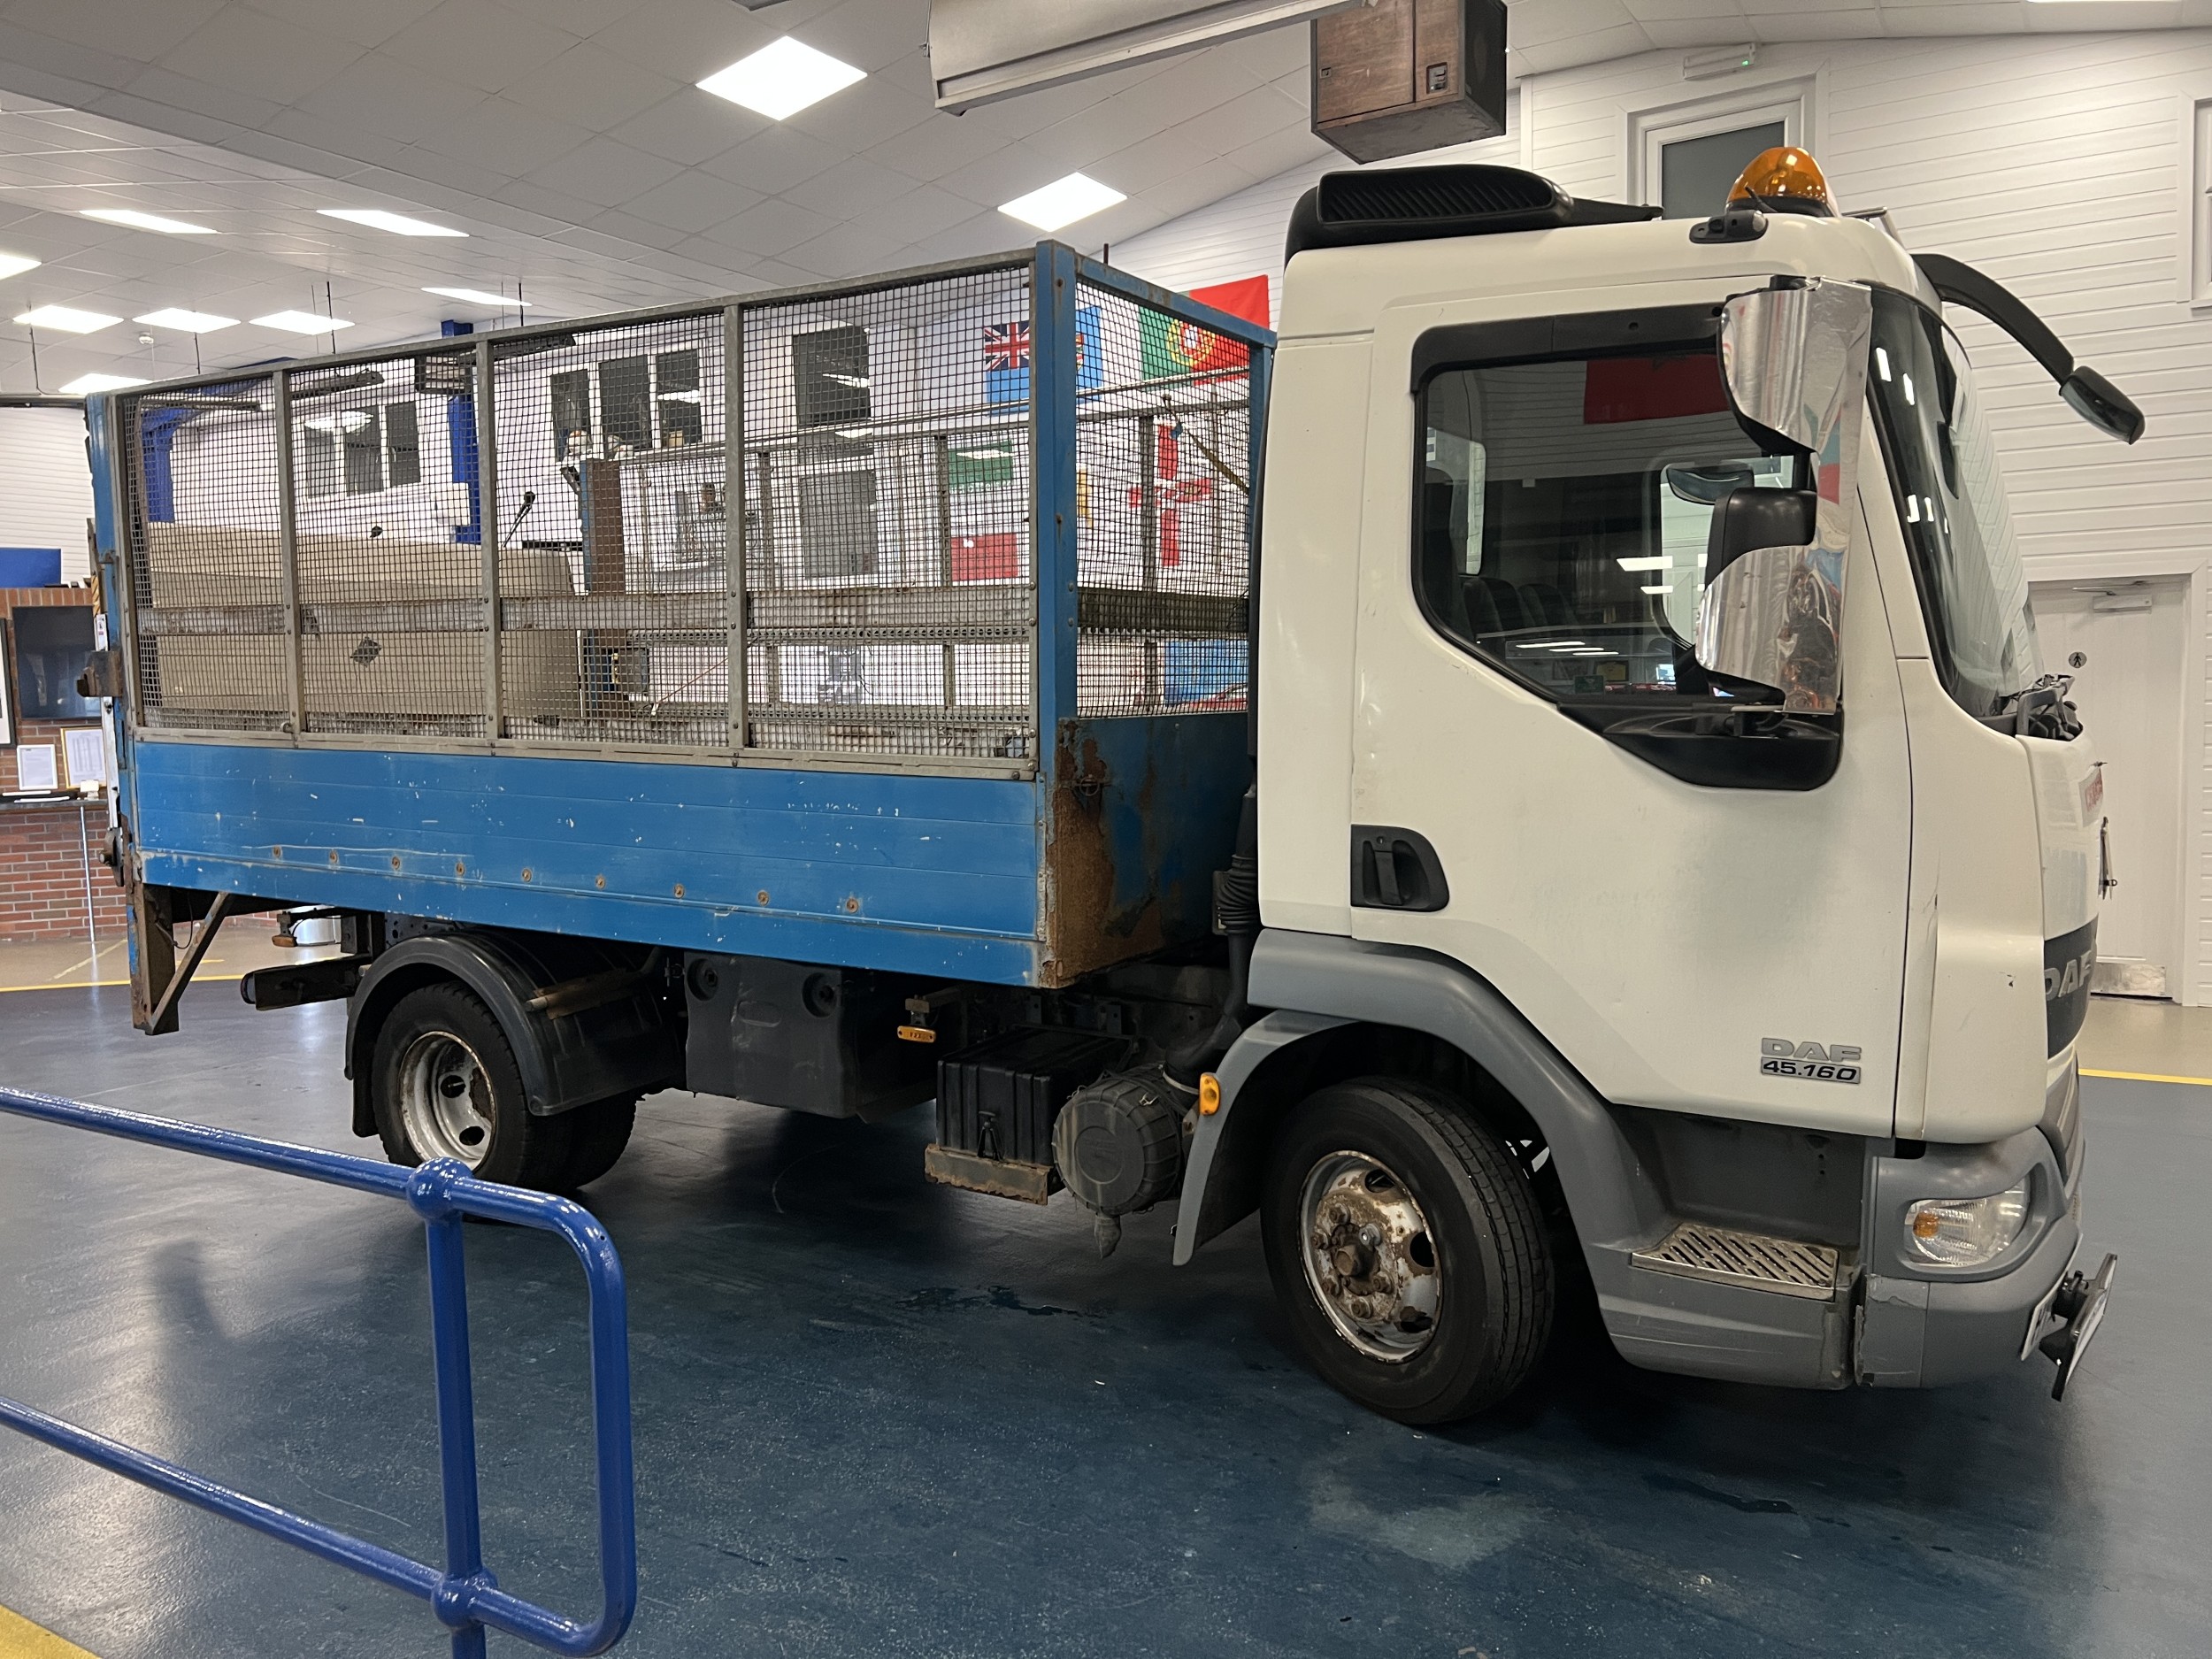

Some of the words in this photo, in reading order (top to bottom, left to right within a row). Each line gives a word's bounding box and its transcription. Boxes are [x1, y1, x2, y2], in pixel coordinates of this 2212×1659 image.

[2044, 949, 2092, 1001] DAF
[1761, 1037, 1862, 1062] DAF
[1763, 1060, 1857, 1081] 45.160
